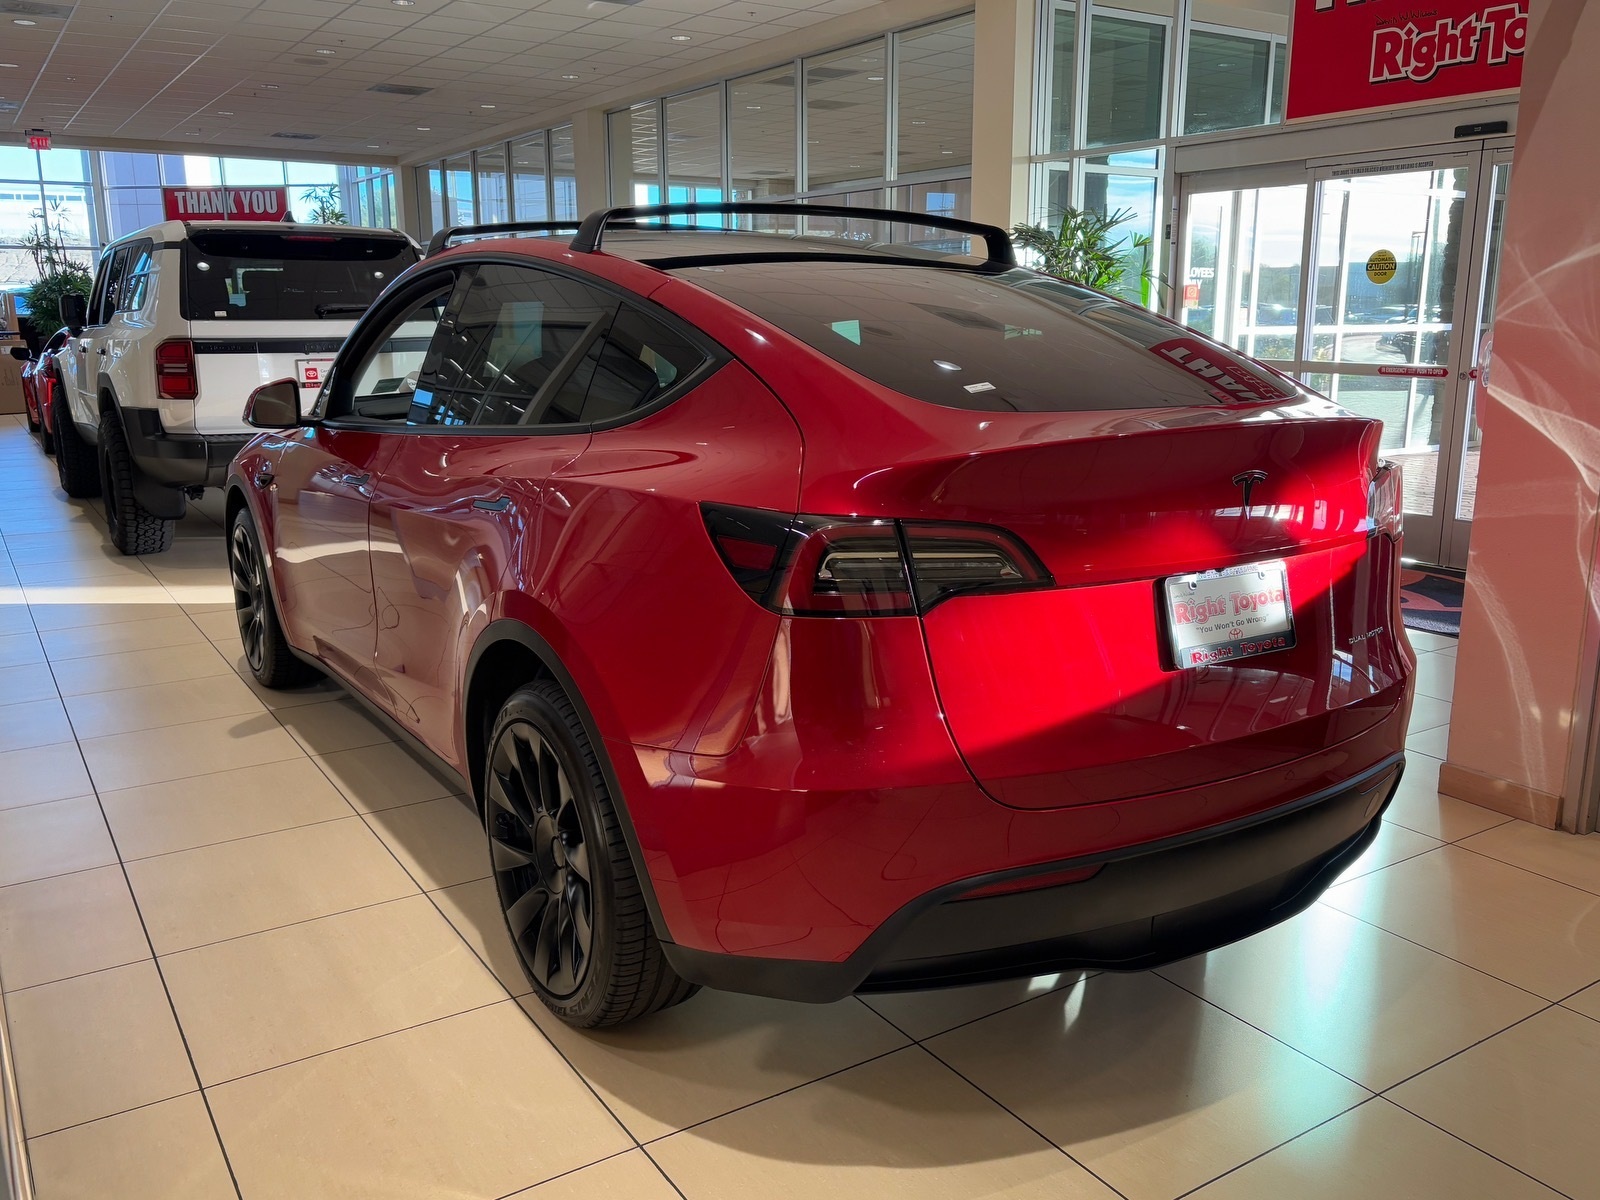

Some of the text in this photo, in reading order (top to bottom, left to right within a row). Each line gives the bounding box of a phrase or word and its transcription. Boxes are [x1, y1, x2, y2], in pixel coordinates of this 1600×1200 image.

[1369, 12, 1480, 83] Right
[174, 190, 278, 214] THANK YOU
[1367, 262, 1395, 271] CAUTION
[1385, 366, 1407, 374] EMERGENCY
[1433, 368, 1443, 376] OPEN
[1174, 595, 1226, 625] Right
[1229, 588, 1285, 616] Toyota
[1214, 620, 1235, 630] Won't
[1235, 619, 1245, 627] Go
[1348, 626, 1384, 645] DUAL MOTOR
[1190, 636, 1286, 664] Right Toyota
